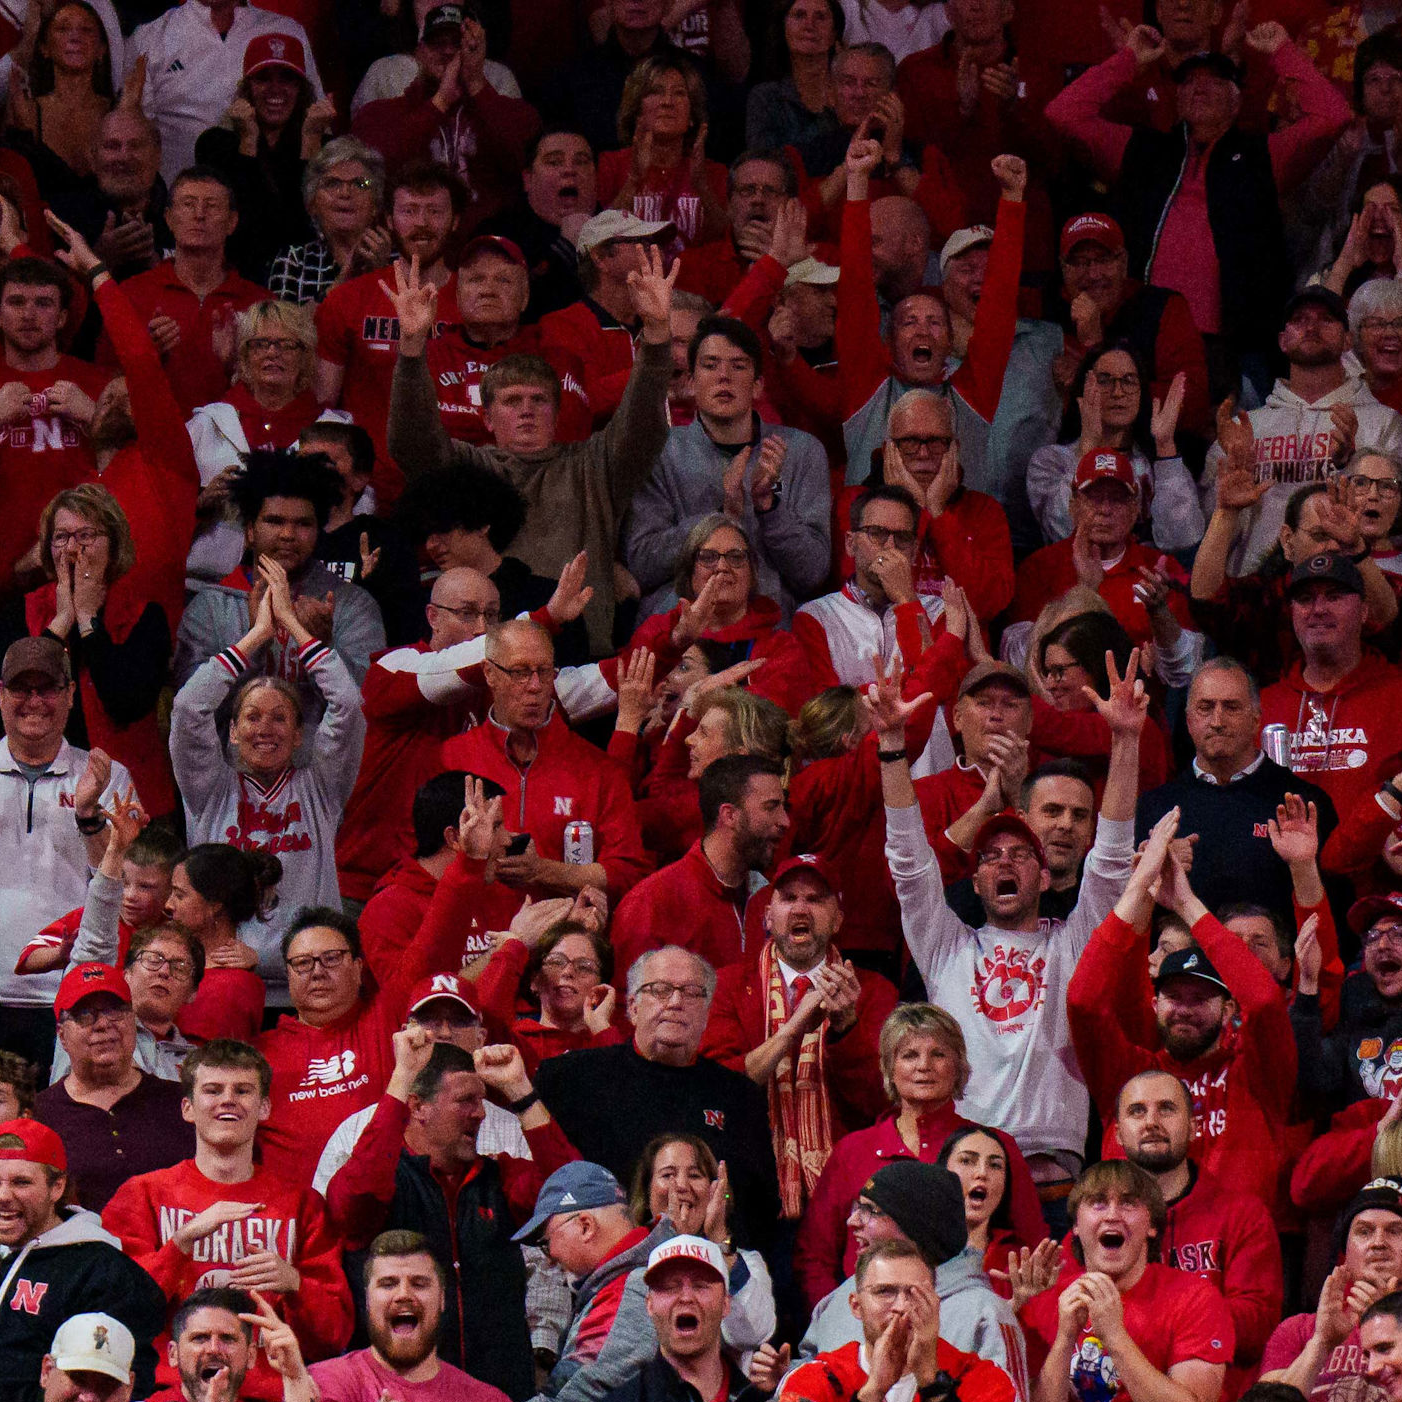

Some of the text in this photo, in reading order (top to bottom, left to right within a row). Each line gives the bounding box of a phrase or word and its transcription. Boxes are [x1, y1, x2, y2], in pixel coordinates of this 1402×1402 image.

[31, 416, 65, 453] N
[59, 791, 76, 809] N
[553, 796, 573, 816] N
[1253, 823, 1268, 839] N
[431, 974, 459, 994] N
[287, 1086, 317, 1102] new
[703, 1108, 726, 1131] N
[8, 1277, 50, 1316] N
